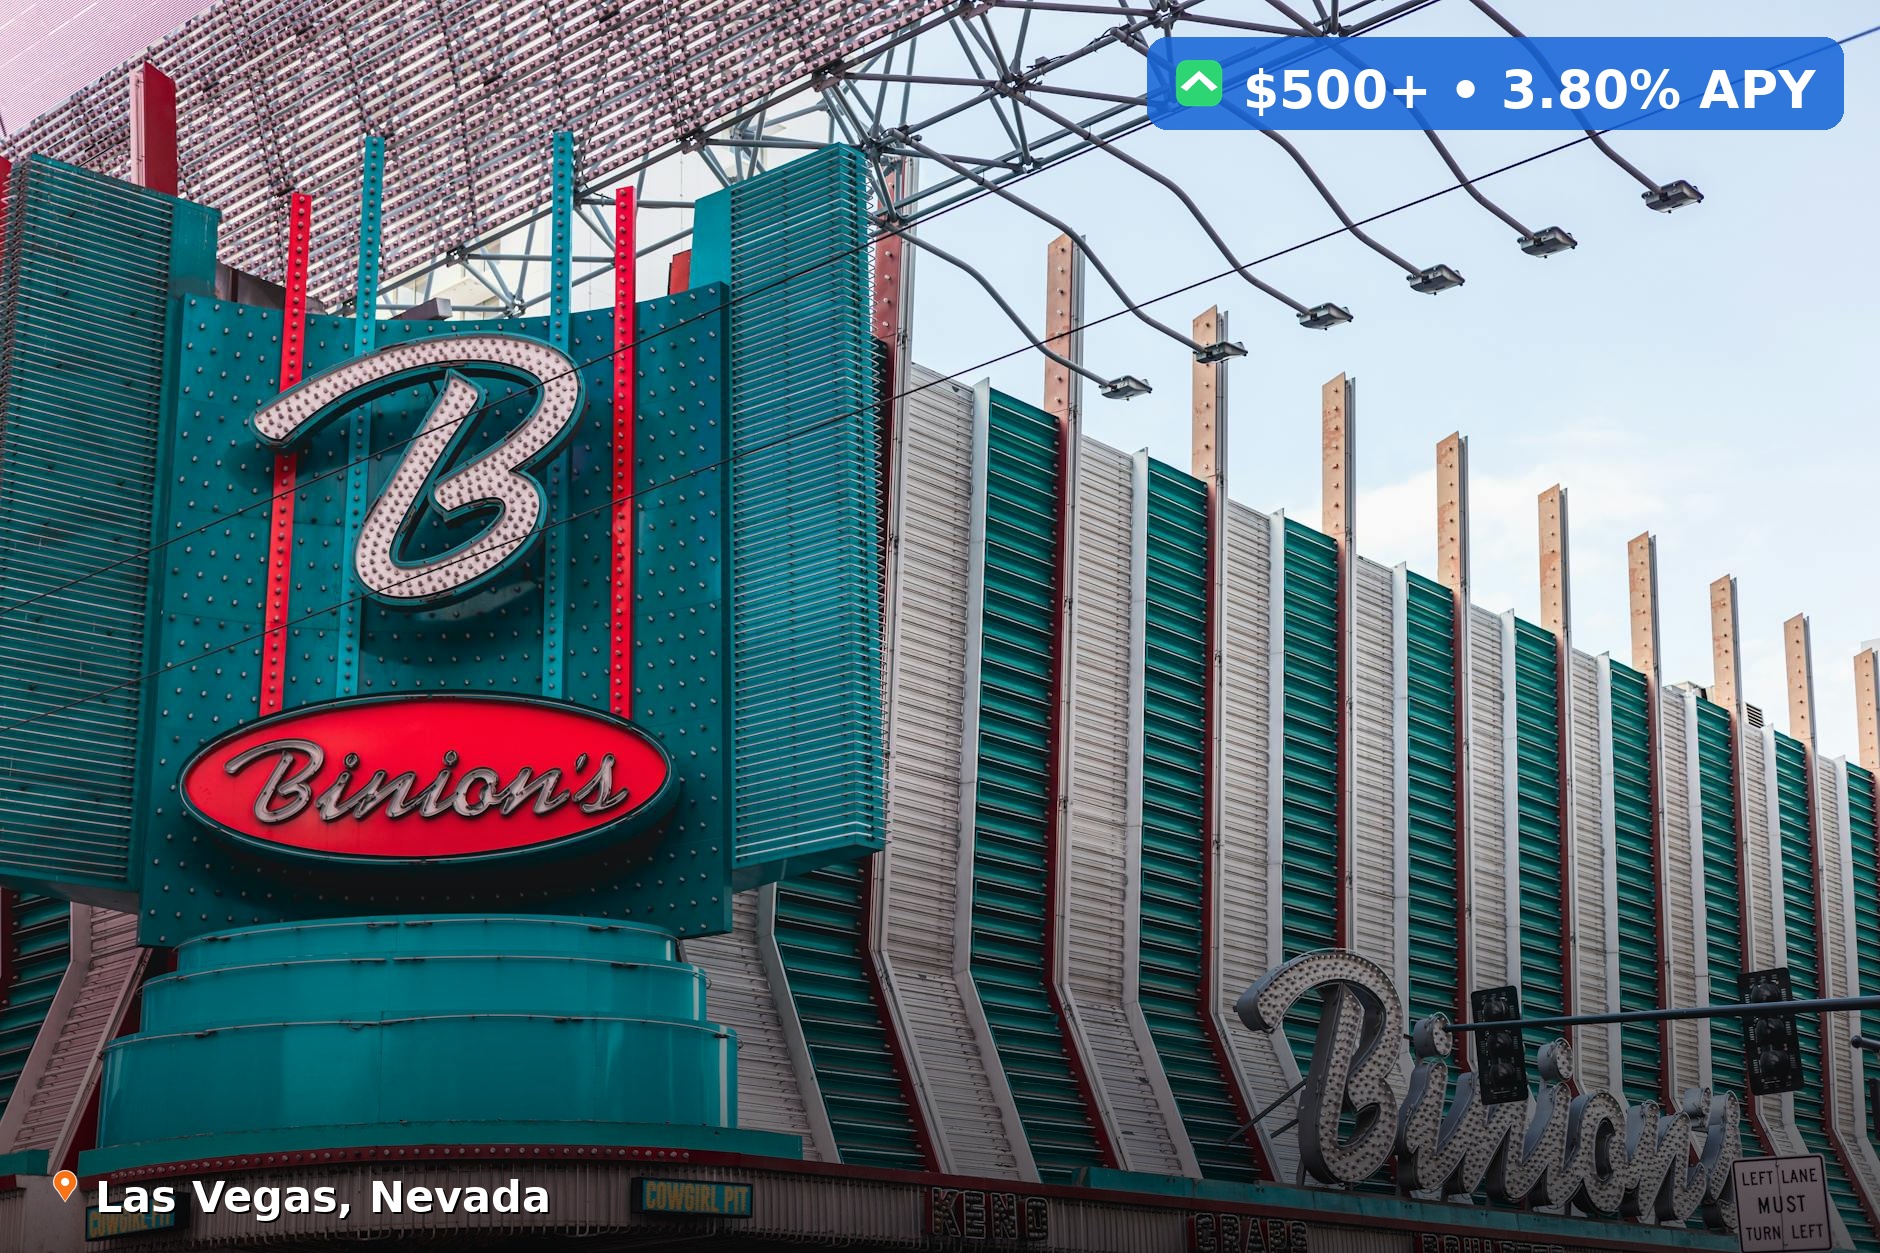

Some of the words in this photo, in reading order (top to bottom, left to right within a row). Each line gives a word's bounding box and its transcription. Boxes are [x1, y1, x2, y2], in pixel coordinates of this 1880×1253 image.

[251, 331, 588, 609] B
[224, 738, 629, 824] Binion's
[1742, 1170, 1773, 1186] LEFT
[1782, 1168, 1818, 1184] LANE
[646, 1180, 719, 1213] COWGIRL
[724, 1185, 748, 1216] PIT
[932, 1187, 1049, 1241] KENO
[1758, 1194, 1805, 1214] MUST
[1746, 1226, 1781, 1241] TURN
[1792, 1224, 1824, 1239] LEFT
